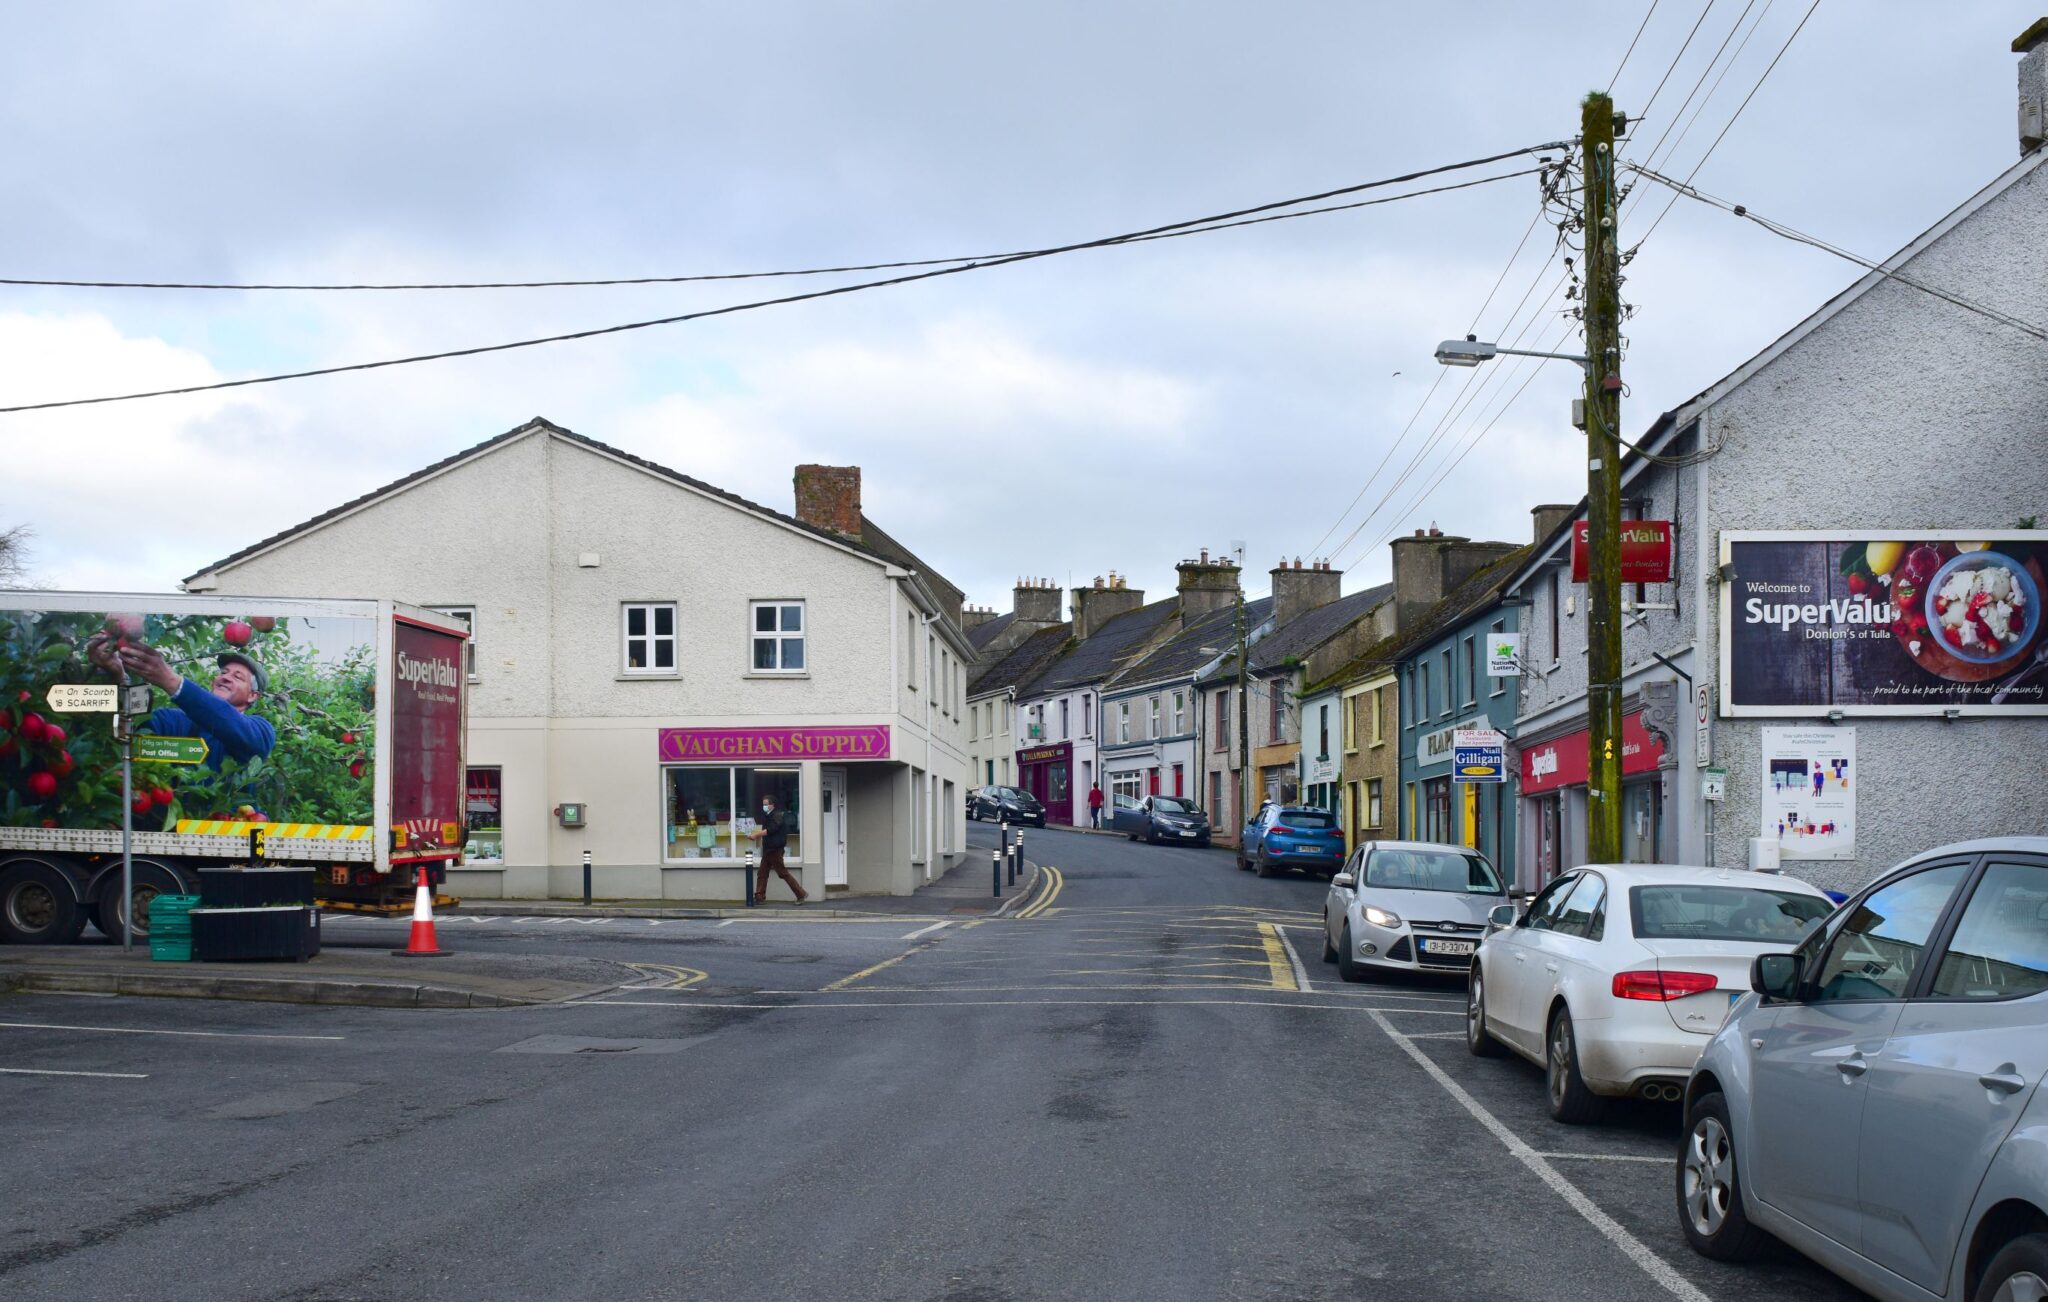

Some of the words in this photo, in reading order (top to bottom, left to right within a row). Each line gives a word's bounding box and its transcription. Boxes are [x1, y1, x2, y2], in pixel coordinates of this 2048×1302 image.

[1581, 529, 1665, 543] SrValu
[1746, 582, 1797, 593] Welcome
[1800, 584, 1810, 593] to
[1746, 598, 1891, 632] SuperValu
[1806, 628, 1856, 639] Donlon's
[1858, 630, 1868, 639] of
[1870, 630, 1891, 639] Tulla
[398, 651, 457, 690] SuperValu
[82, 688, 115, 696] Scairbh
[1901, 684, 1910, 694] to
[1912, 683, 1922, 694] be
[1922, 684, 1945, 698] part
[1946, 683, 1957, 696] of
[1957, 682, 1972, 694] the
[1973, 683, 1993, 694] local
[1994, 685, 2044, 699] community
[672, 735, 784, 756] VAUGHAN
[790, 733, 876, 754] SUPPLY
[158, 749, 179, 757] Office
[1456, 752, 1501, 766] Gilligan
[1532, 748, 1558, 784] SuperValu
